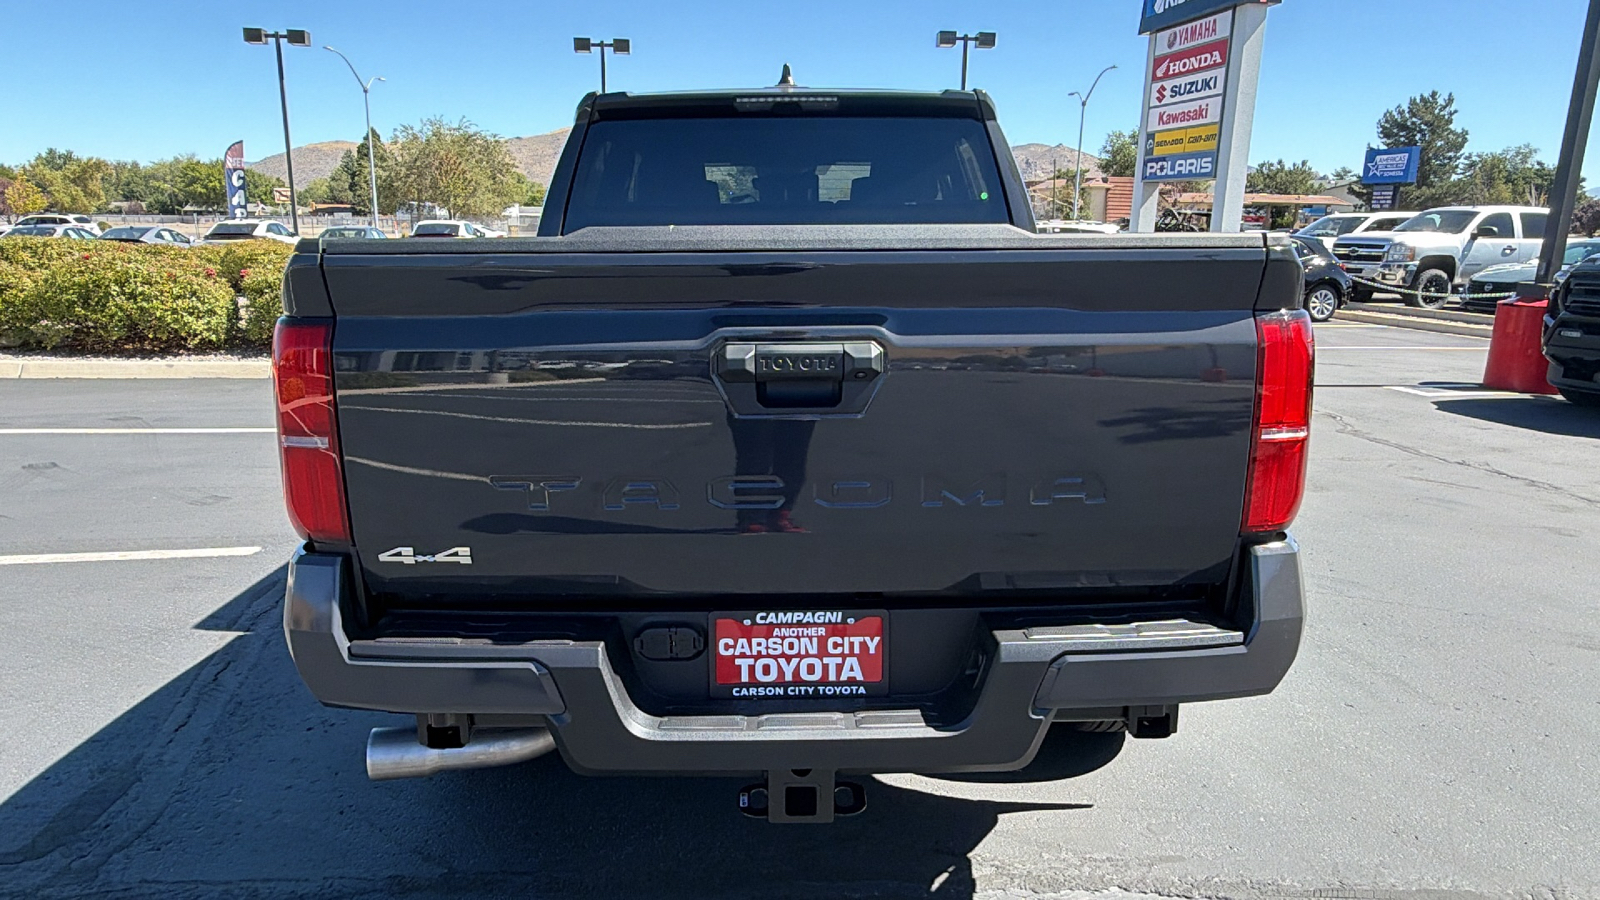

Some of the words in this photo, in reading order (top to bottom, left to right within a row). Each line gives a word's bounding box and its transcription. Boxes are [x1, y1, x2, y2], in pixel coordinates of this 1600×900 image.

[1179, 18, 1217, 46] YAMAHA
[1168, 50, 1222, 75] HONDA
[1169, 75, 1218, 98] SUZUKI
[1158, 103, 1209, 126] Kawasaki
[1146, 157, 1212, 176] POLARIS
[1378, 155, 1406, 163] AMERICAS
[759, 356, 837, 371] TOYOTA
[488, 471, 1107, 511] TACOMA
[378, 547, 472, 564] 4x4
[755, 611, 842, 625] CAMPAGNI
[773, 627, 826, 637] ANOTHER
[718, 637, 818, 656] CARSON
[827, 636, 881, 654] CITY
[735, 657, 864, 682] TOYOTA
[732, 687, 784, 697] CARSON
[787, 686, 814, 696] CITY
[817, 685, 867, 695] TOYOTA
